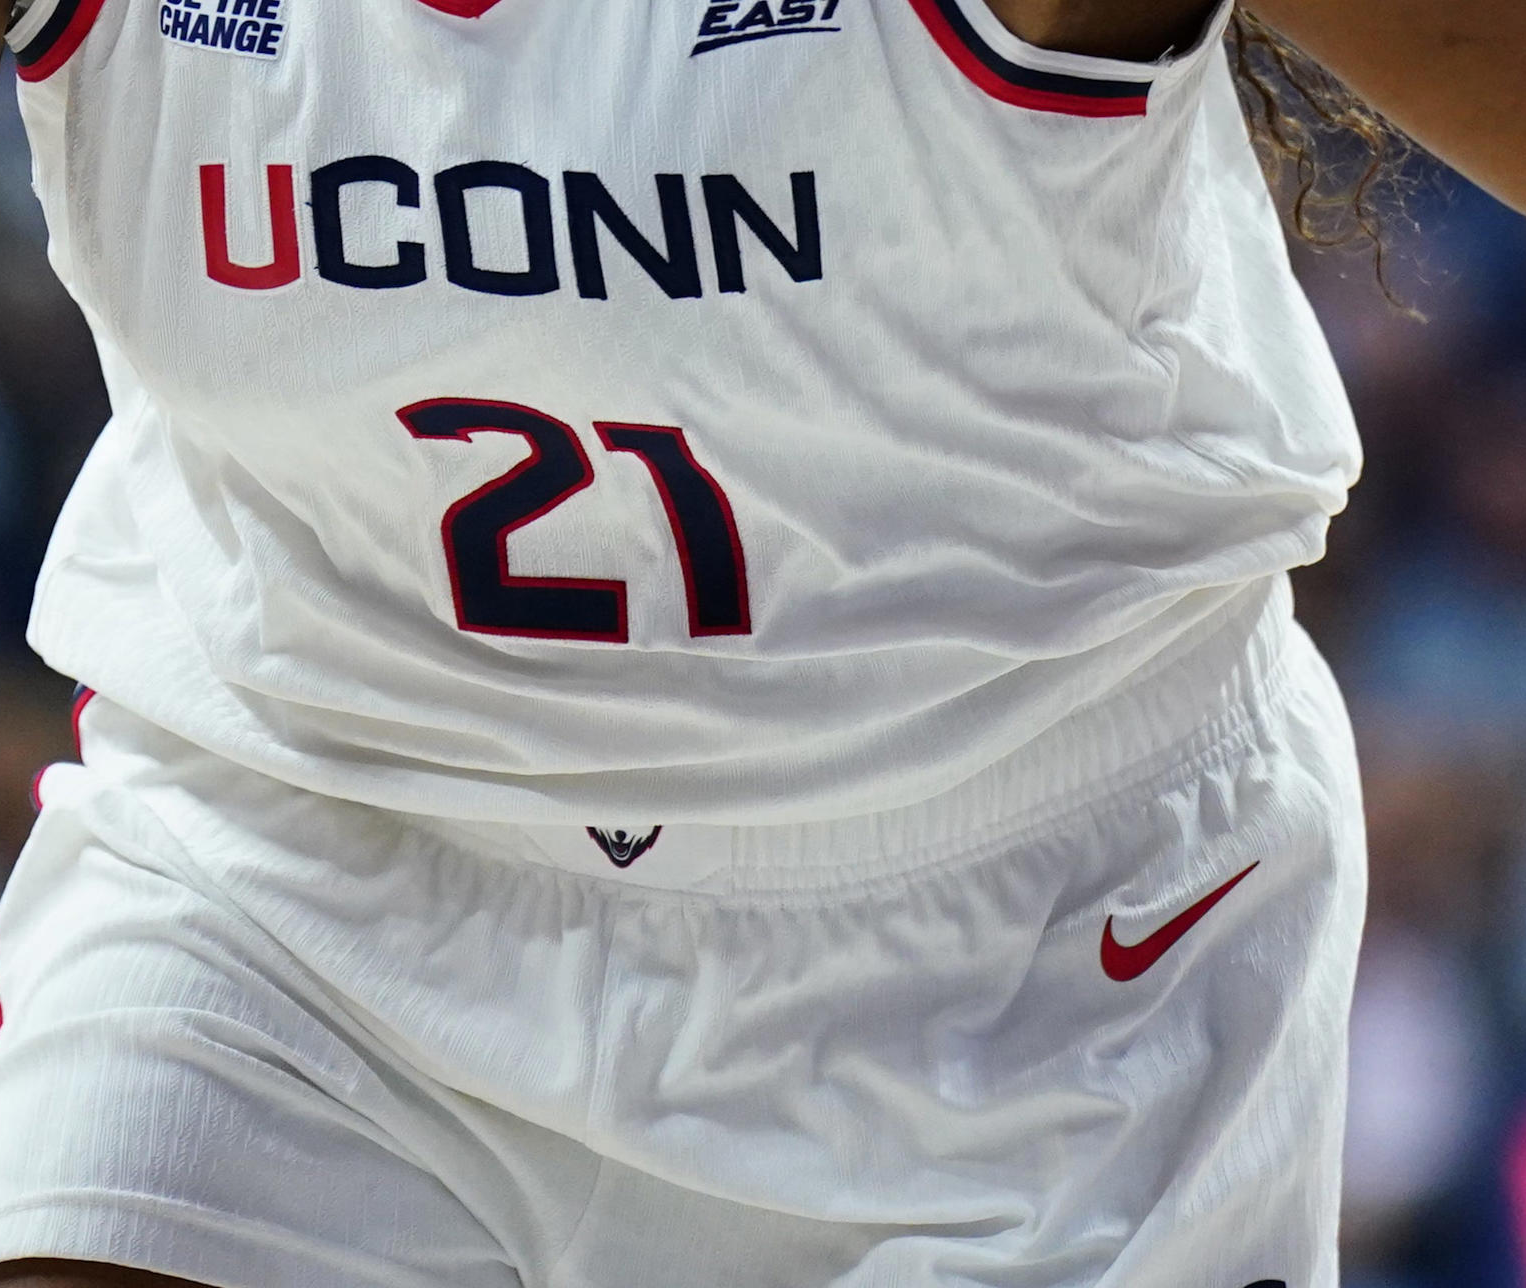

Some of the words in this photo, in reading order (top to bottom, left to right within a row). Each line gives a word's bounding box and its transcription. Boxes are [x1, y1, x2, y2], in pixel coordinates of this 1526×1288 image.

[160, 5, 283, 55] CHANGE
[198, 155, 823, 299] UCONN
[396, 397, 752, 643] 21
